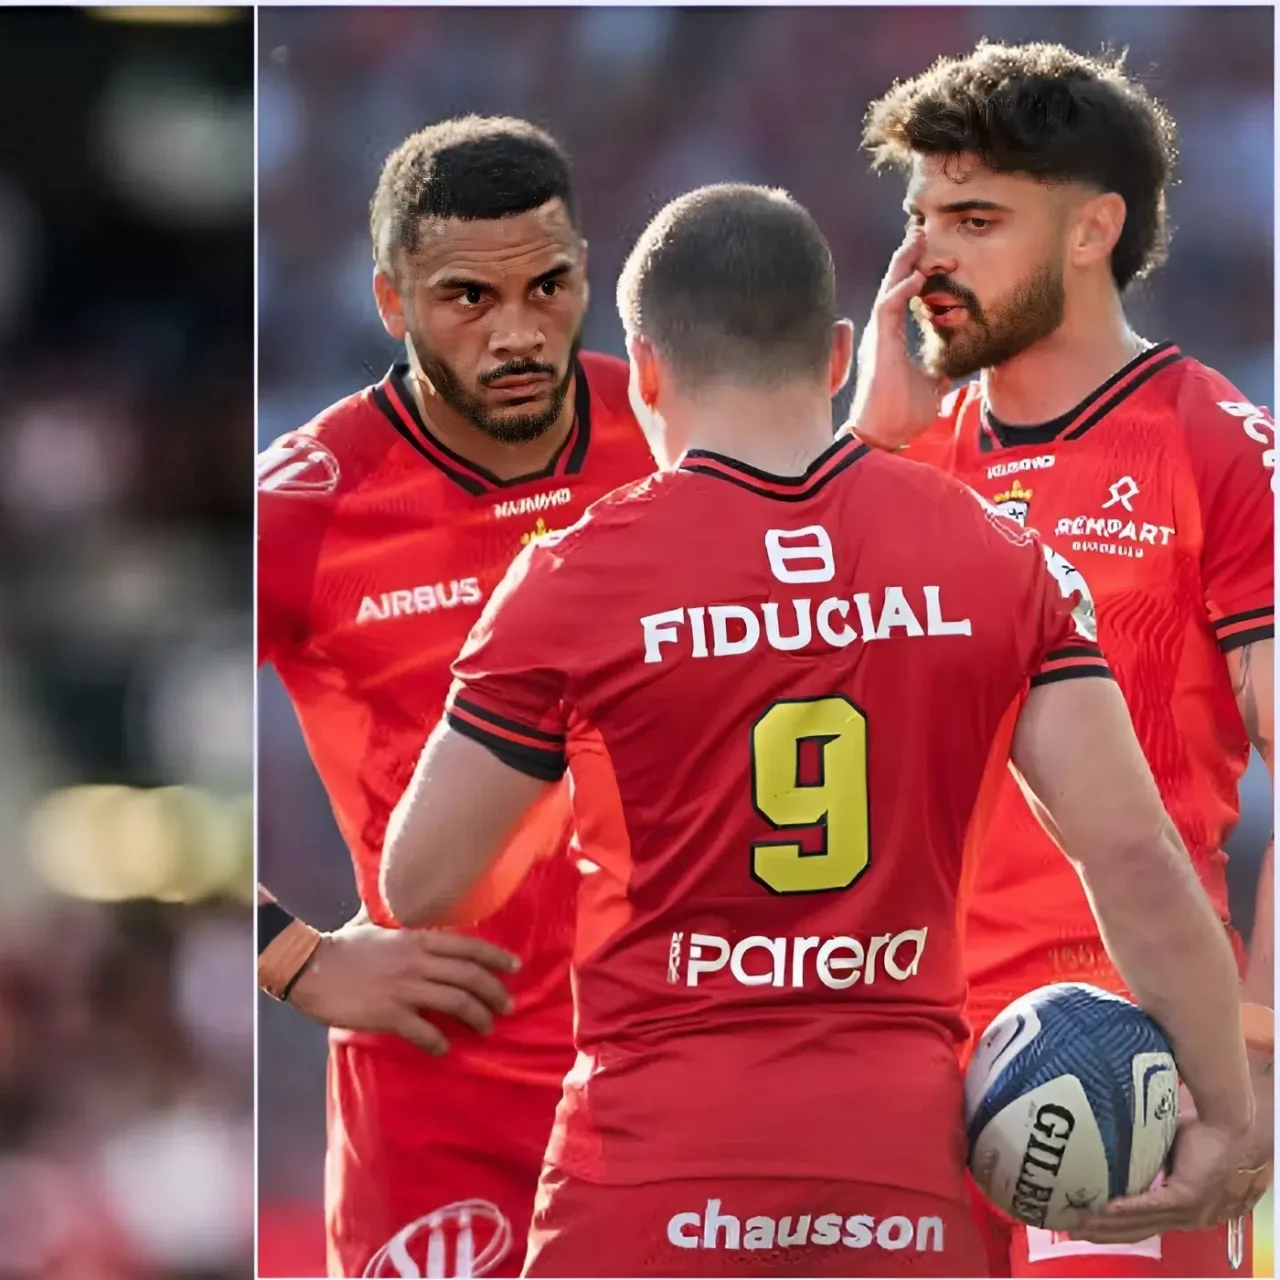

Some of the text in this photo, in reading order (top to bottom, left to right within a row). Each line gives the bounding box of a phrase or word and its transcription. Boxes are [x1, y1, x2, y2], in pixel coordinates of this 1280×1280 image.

[355, 576, 483, 627] AIRBUS
[639, 585, 973, 664] FIDUCIAL
[749, 692, 871, 897] 9
[686, 926, 929, 990] Parera
[666, 1198, 946, 1252] chausson
